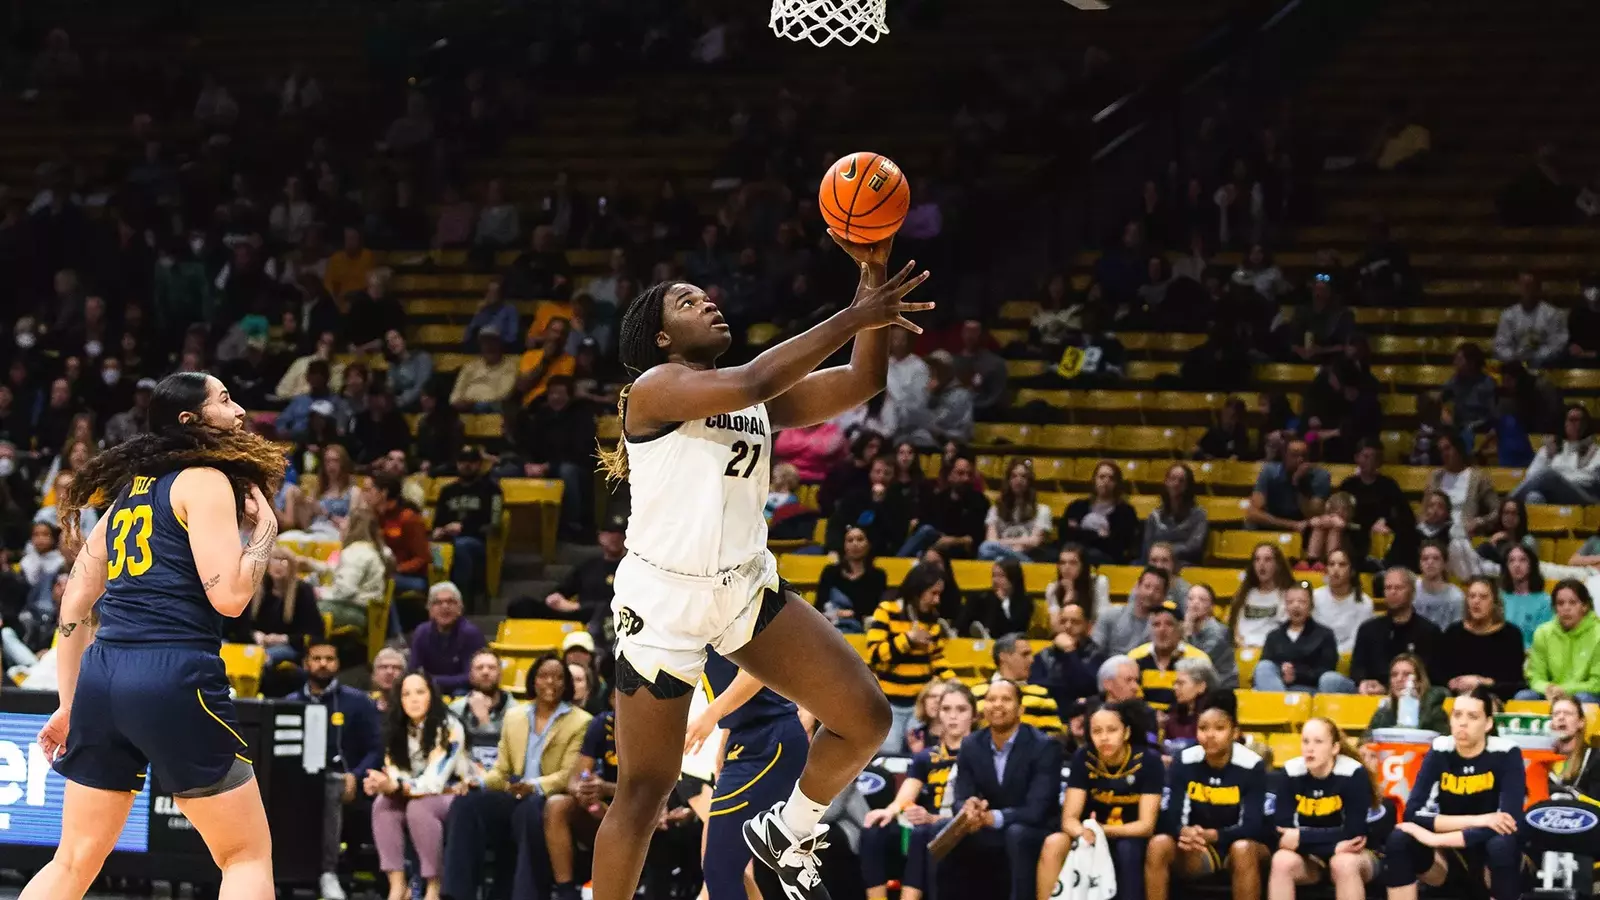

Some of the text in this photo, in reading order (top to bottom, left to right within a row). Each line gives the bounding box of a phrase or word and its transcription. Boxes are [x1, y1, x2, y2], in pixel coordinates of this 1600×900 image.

[724, 440, 762, 478] 21
[107, 504, 153, 580] 33
[1538, 809, 1586, 830] Ford
